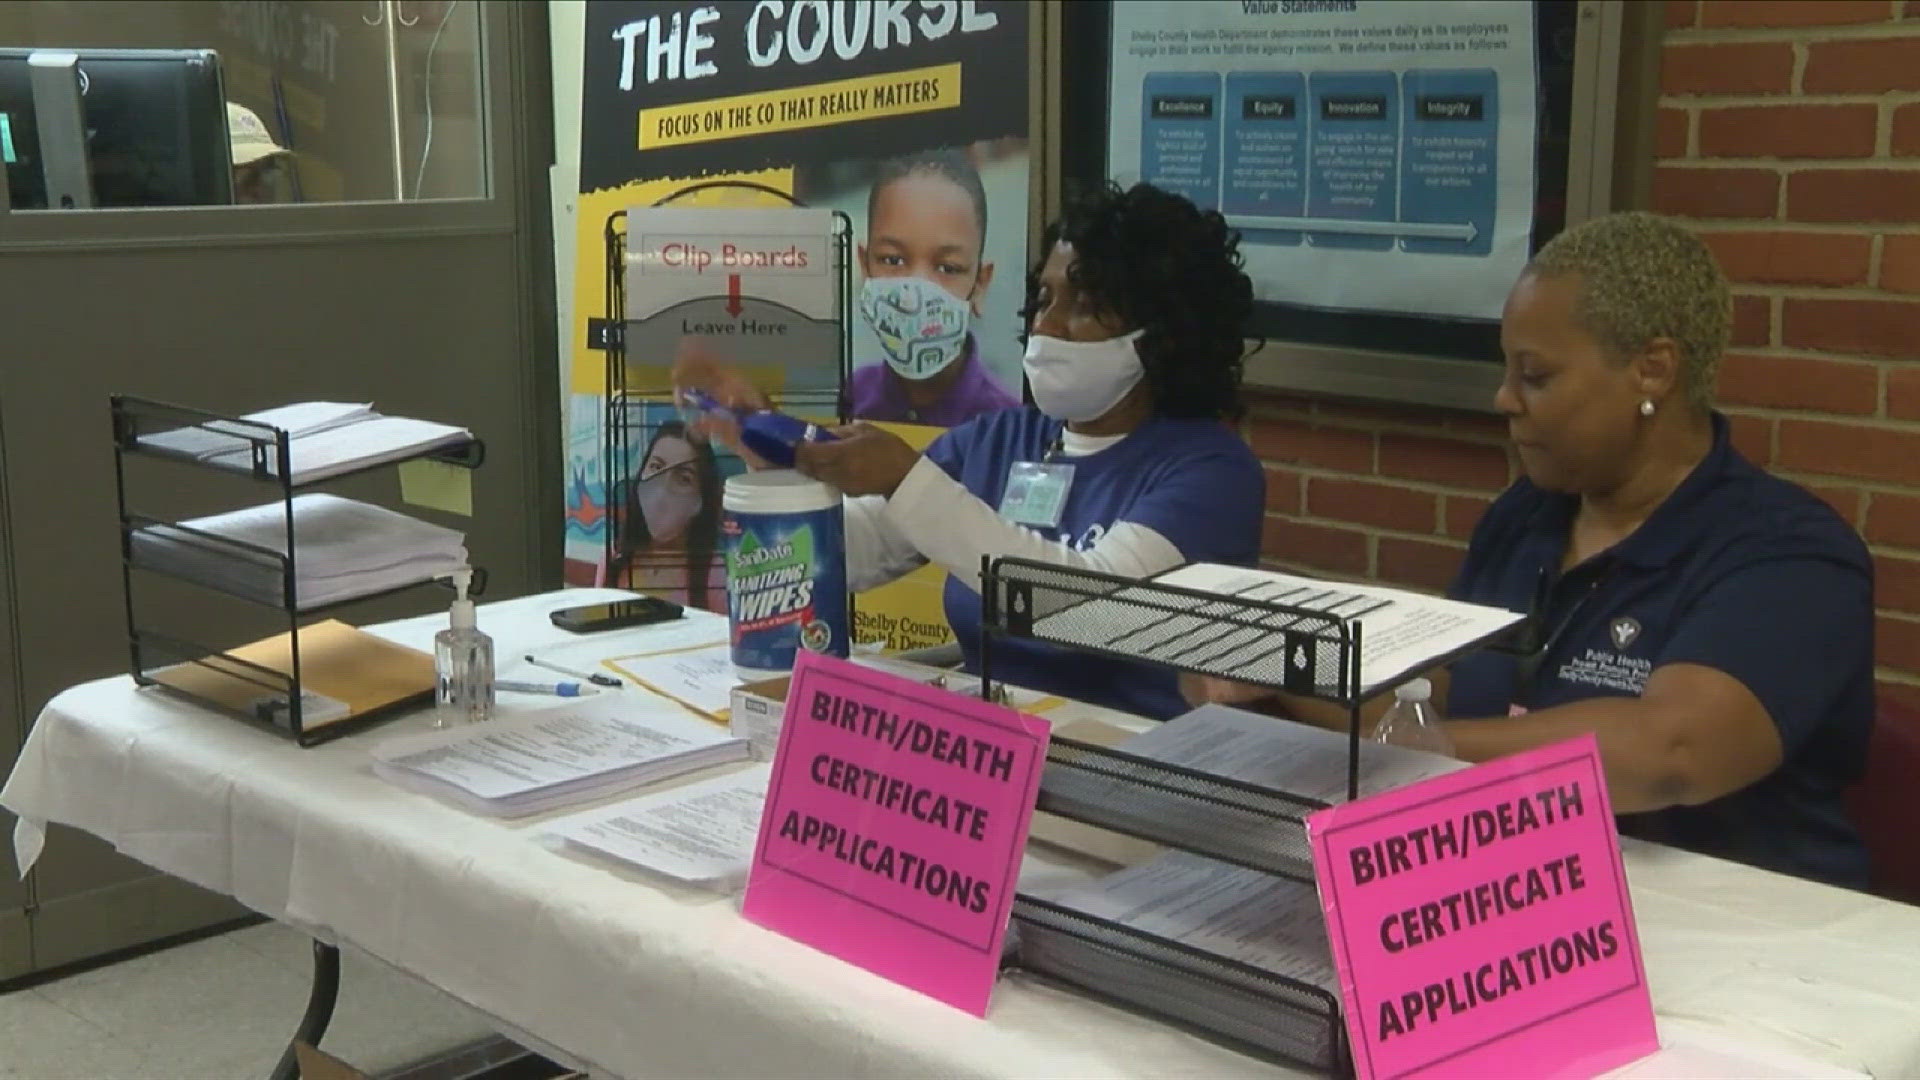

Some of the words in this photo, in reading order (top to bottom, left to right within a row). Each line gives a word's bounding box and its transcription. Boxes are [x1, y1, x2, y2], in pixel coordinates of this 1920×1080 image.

[1242, 0, 1278, 14] Value
[1281, 0, 1356, 13] Statements
[1451, 23, 1509, 36] employees
[612, 6, 721, 91] THE
[658, 113, 699, 138] FOCUS
[704, 111, 722, 132] ON
[728, 107, 752, 127] THE
[757, 104, 773, 125] CO
[780, 97, 813, 121] THAT
[820, 90, 868, 115] REALLY
[873, 78, 940, 109] MATTERS
[1254, 101, 1283, 115] Equity
[1329, 102, 1379, 114] Innovation
[1428, 102, 1470, 115] Integrity
[662, 243, 711, 274] Clip
[723, 243, 808, 268] Boards
[683, 319, 736, 336] Leave
[742, 319, 788, 336] Here
[734, 563, 804, 593] SANITIZING
[739, 580, 814, 621] WIPES
[855, 611, 897, 632] Shelby
[901, 617, 949, 643] County
[1617, 654, 1651, 671] Health
[810, 690, 1015, 782] BIRTH/DEATH
[811, 754, 989, 841] CERTIFICATE
[1350, 782, 1584, 886] BIRTH/DEATH
[780, 810, 991, 914] APPLICATIONS
[1380, 854, 1586, 954] CERTIFICATE
[1379, 921, 1619, 1042] APPLICATIONS
